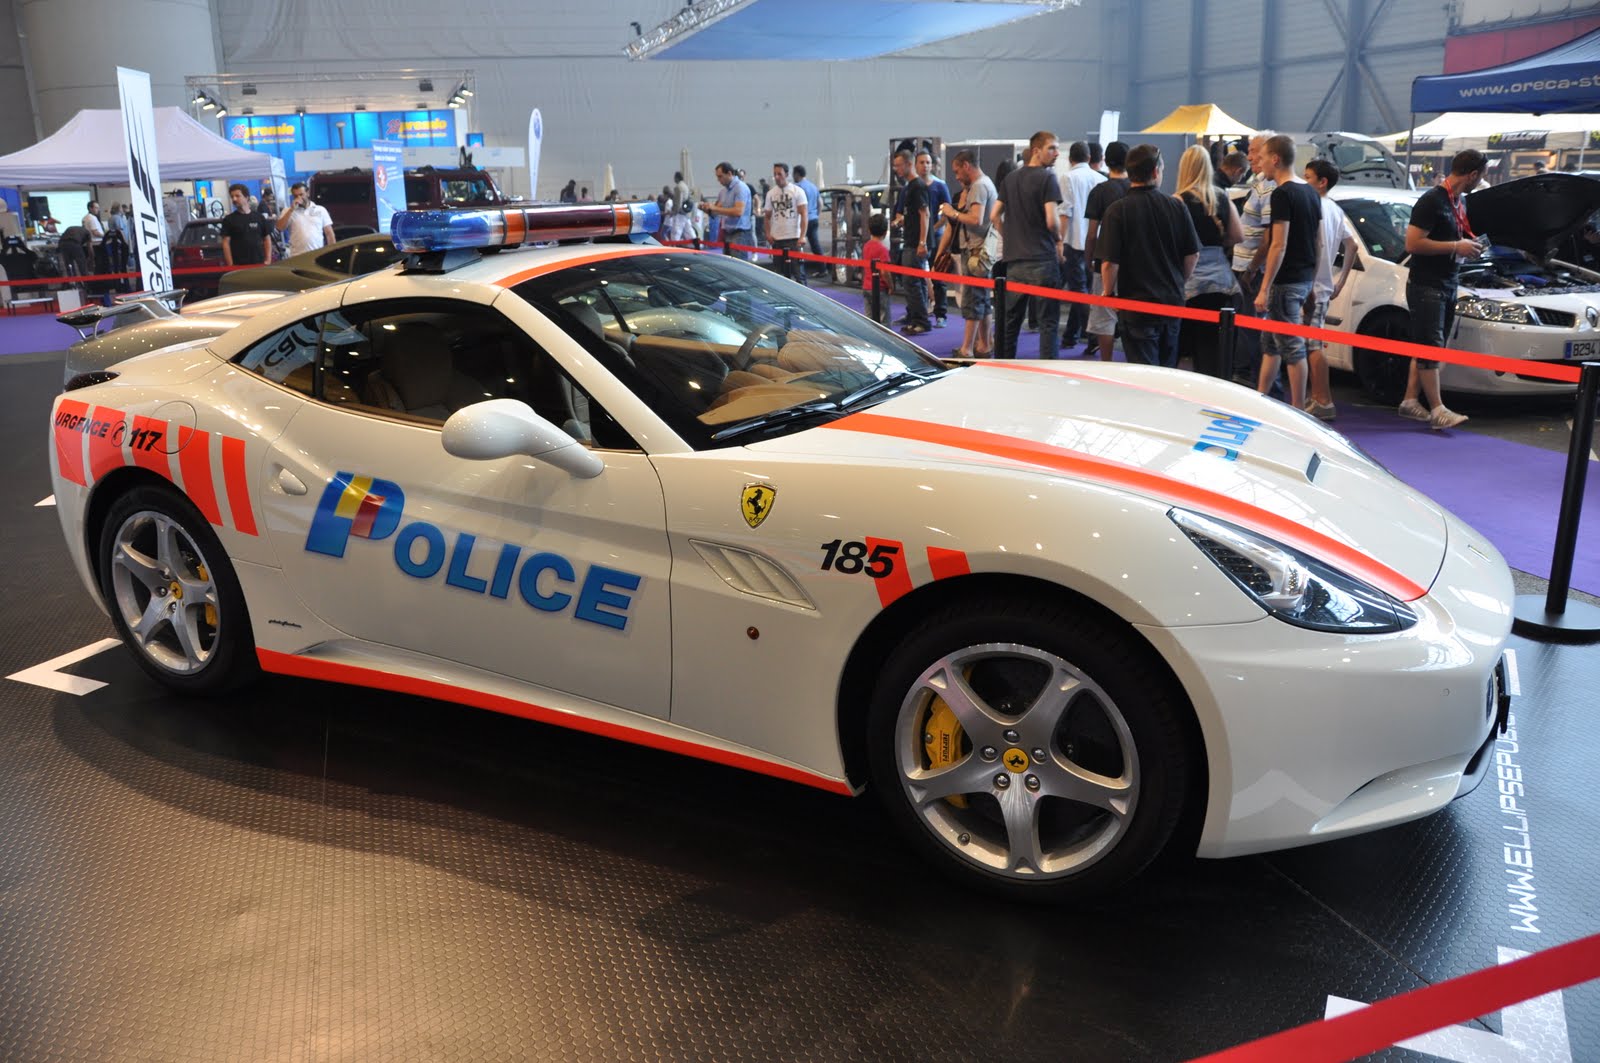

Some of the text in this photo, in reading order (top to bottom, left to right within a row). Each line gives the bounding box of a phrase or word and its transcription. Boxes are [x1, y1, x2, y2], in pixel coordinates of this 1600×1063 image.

[1573, 342, 1596, 357] 8294
[55, 411, 163, 452] URGENCE 117
[304, 470, 643, 631] POLICE
[819, 539, 900, 579] 185
